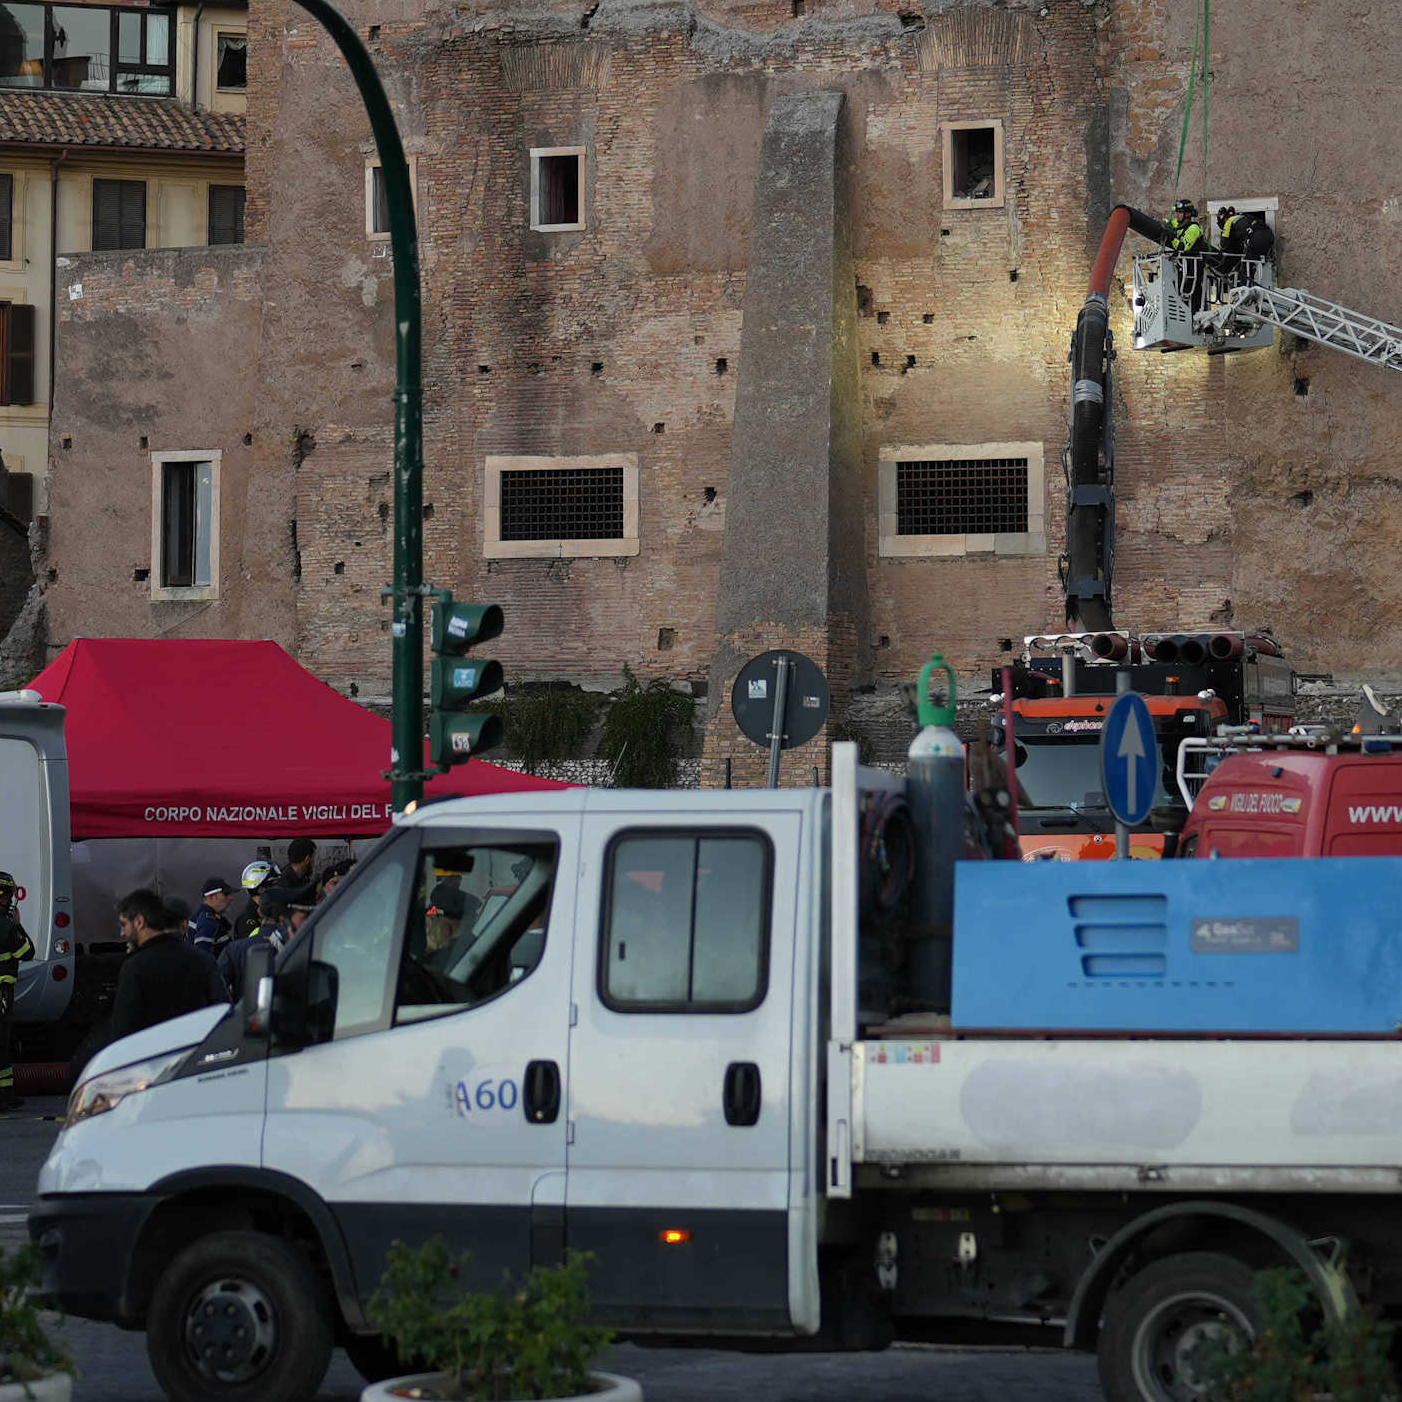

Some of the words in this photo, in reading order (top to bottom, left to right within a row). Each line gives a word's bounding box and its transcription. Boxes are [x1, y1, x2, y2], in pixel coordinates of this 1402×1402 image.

[144, 806, 203, 822] CORPO
[206, 806, 299, 821] NAZIONALE
[302, 805, 347, 820] VIGILI
[350, 804, 382, 819] DEL
[456, 1079, 518, 1111] A60
